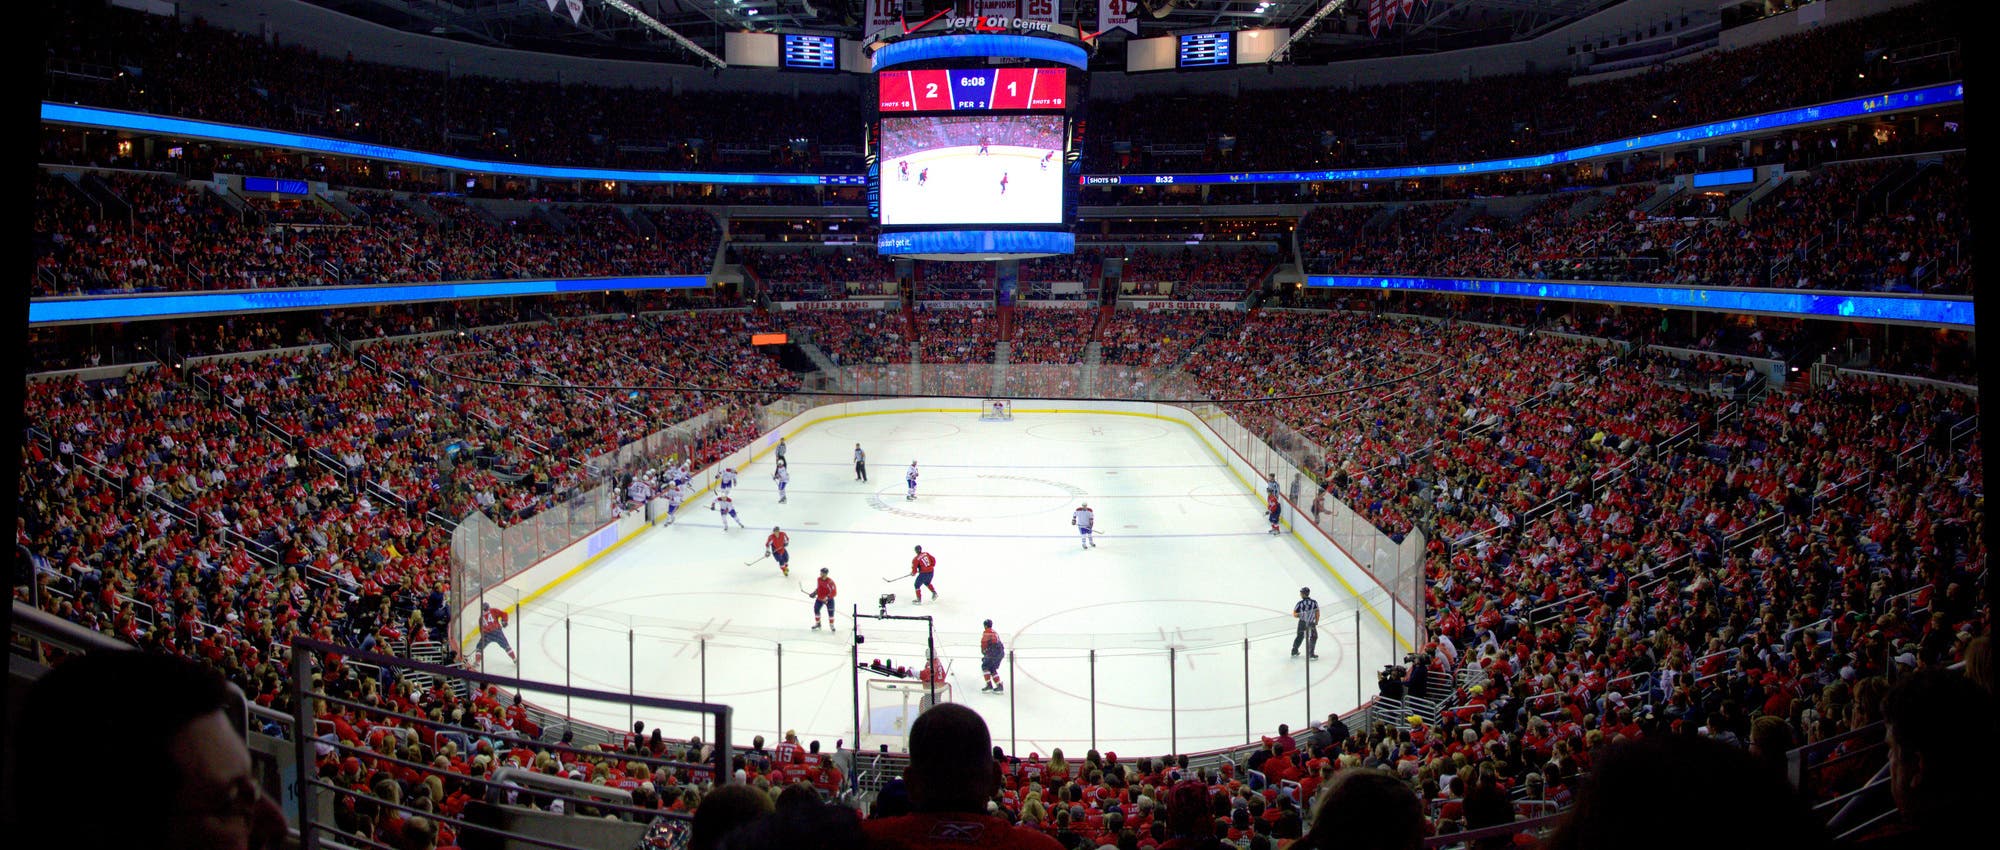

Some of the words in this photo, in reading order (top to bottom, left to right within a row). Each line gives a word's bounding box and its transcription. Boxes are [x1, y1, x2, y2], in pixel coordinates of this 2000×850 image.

[945, 14, 1009, 31] verizon
[1013, 18, 1052, 31] Center
[960, 77, 986, 87] 6:08
[1007, 81, 1017, 97] 1
[925, 82, 938, 99] 2
[1176, 302, 1207, 310] CRAZY
